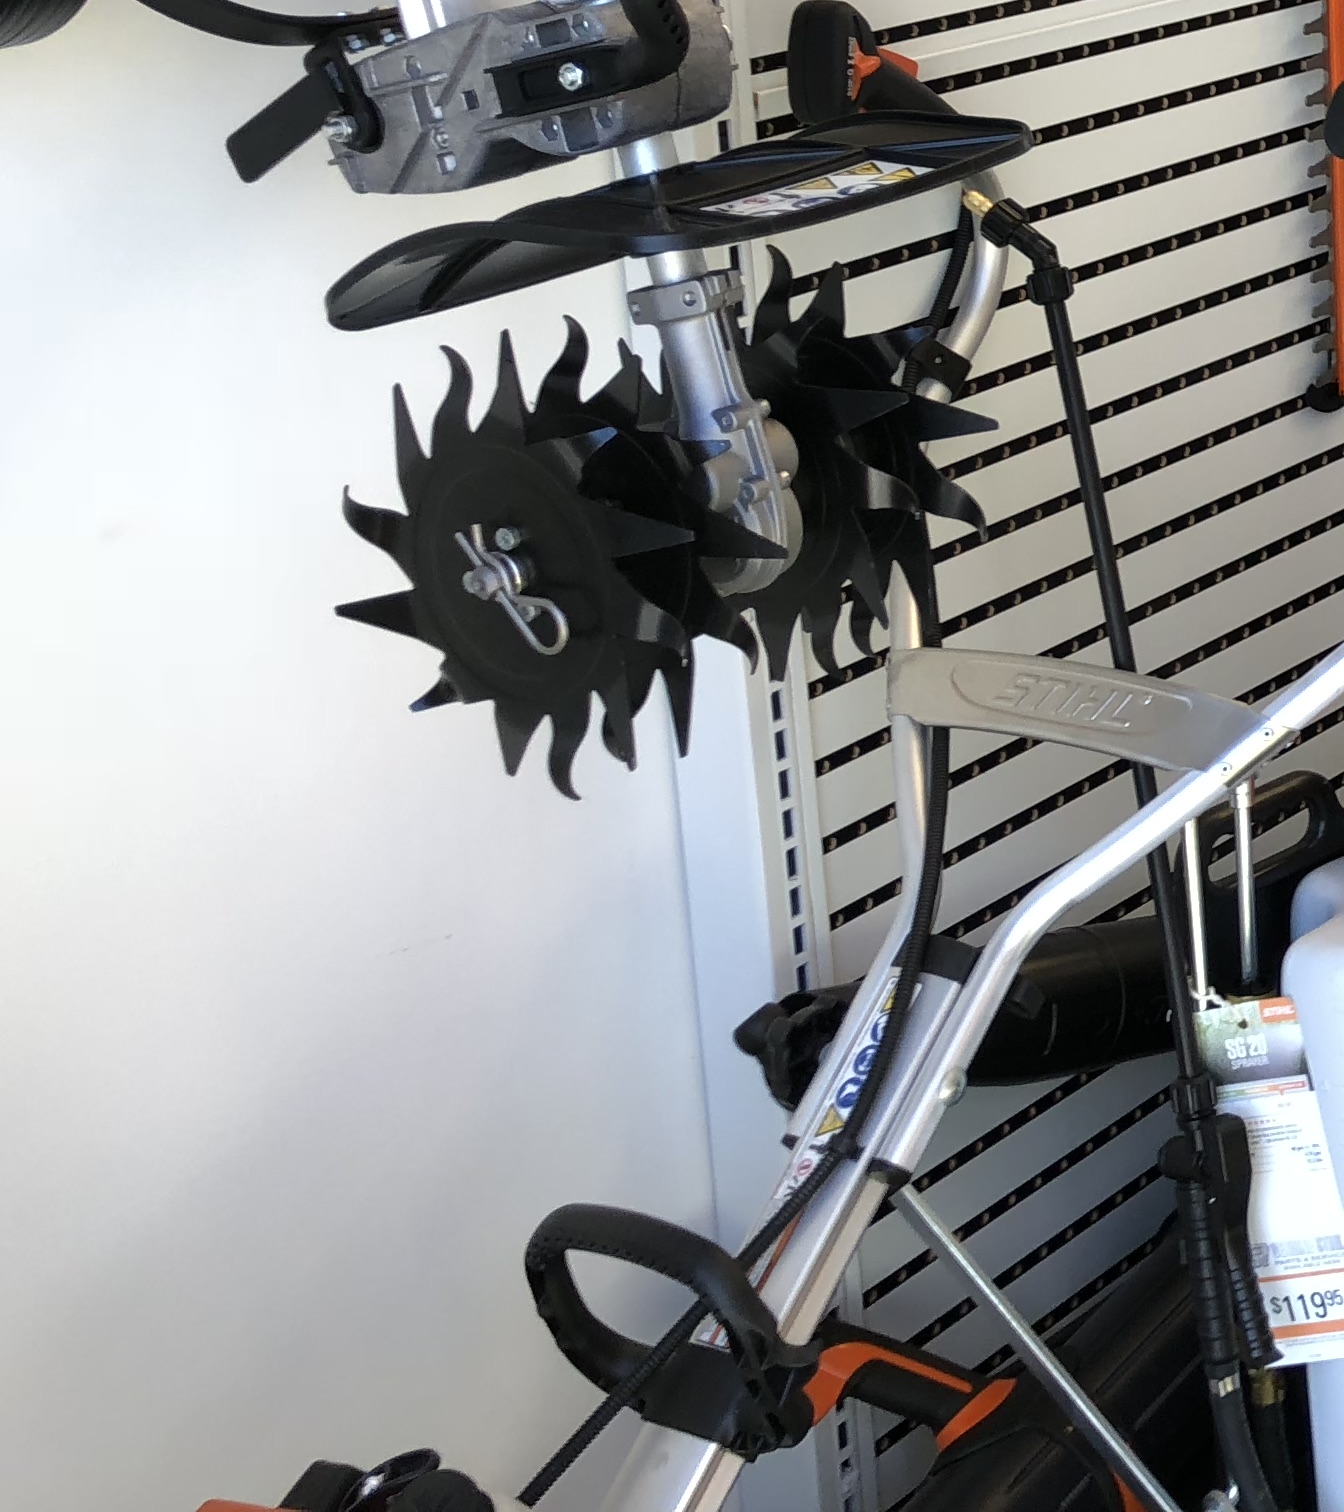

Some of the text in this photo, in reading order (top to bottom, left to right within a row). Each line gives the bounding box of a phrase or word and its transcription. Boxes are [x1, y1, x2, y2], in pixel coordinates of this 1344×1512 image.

[990, 672, 1141, 728] STIHL
[1263, 1005, 1296, 1018] STIHL
[1224, 1033, 1268, 1060] SG 20
[1231, 1055, 1270, 1071] SPRAYER
